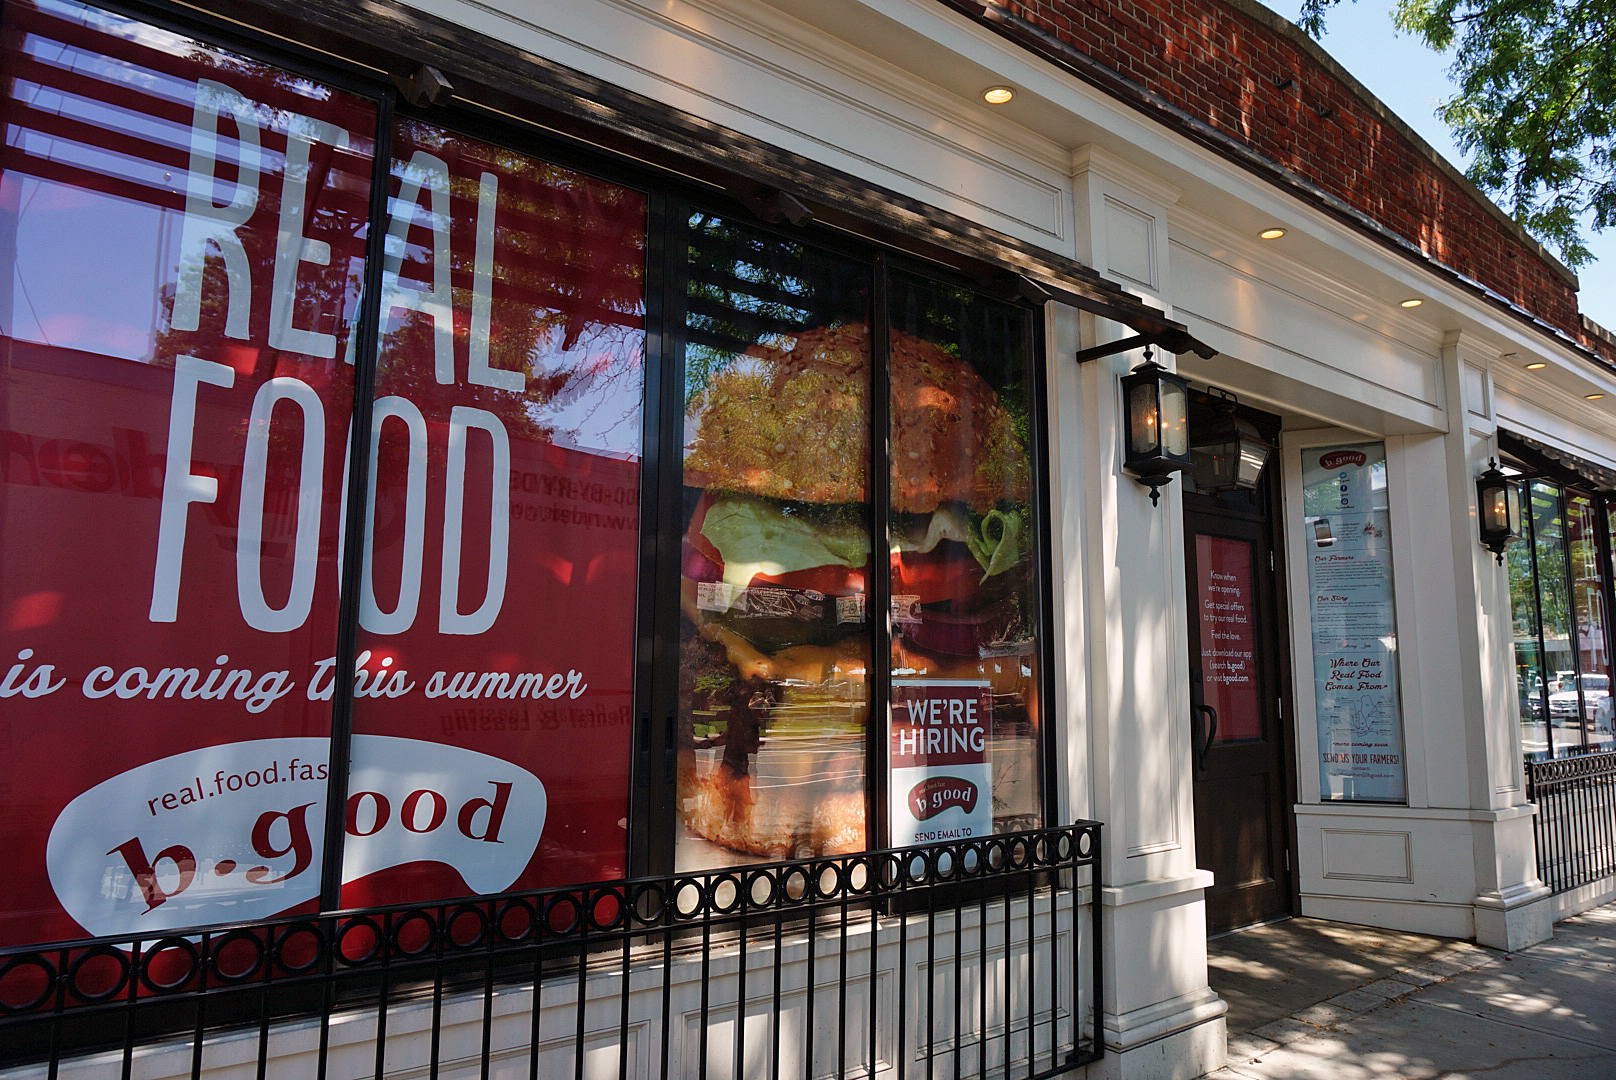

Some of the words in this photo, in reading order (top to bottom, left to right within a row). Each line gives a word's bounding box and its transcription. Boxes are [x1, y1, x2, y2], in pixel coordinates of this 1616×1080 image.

[170, 78, 526, 391] REAL
[149, 354, 511, 636] FOOD
[1210, 570, 1223, 580] Know
[1224, 572, 1237, 581] when
[1208, 583, 1221, 592] we're
[1204, 599, 1215, 609] Get
[1216, 601, 1230, 612] special
[1230, 602, 1245, 611] offers
[1226, 614, 1235, 622] real
[1210, 629, 1221, 639] Feel
[1221, 630, 1230, 639] the
[1201, 647, 1211, 656] Just
[1212, 647, 1234, 657] download
[1243, 651, 1252, 660] app
[1210, 660, 1226, 669] (search
[1226, 660, 1246, 672] b.good)
[1330, 657, 1359, 668] Where
[1361, 658, 1381, 668] Our
[0, 648, 67, 699] is
[82, 654, 295, 714] coming
[306, 650, 416, 701] this
[424, 665, 588, 700] summer
[1213, 673, 1222, 681] visit
[1222, 672, 1249, 685] bgood.com
[1330, 670, 1355, 681] Real
[1357, 670, 1382, 679] Food
[1325, 682, 1354, 691] Comes
[907, 698, 978, 726] WE'RE
[900, 727, 985, 756] HIRING
[1322, 752, 1338, 763] SEND
[1341, 754, 1350, 763] US
[1352, 754, 1368, 764] YOUR
[1369, 753, 1400, 765] FARMERS!
[148, 758, 352, 815] real.food.fas
[914, 831, 936, 842] SEND
[937, 829, 961, 840] EMAIL
[961, 827, 972, 836] TO
